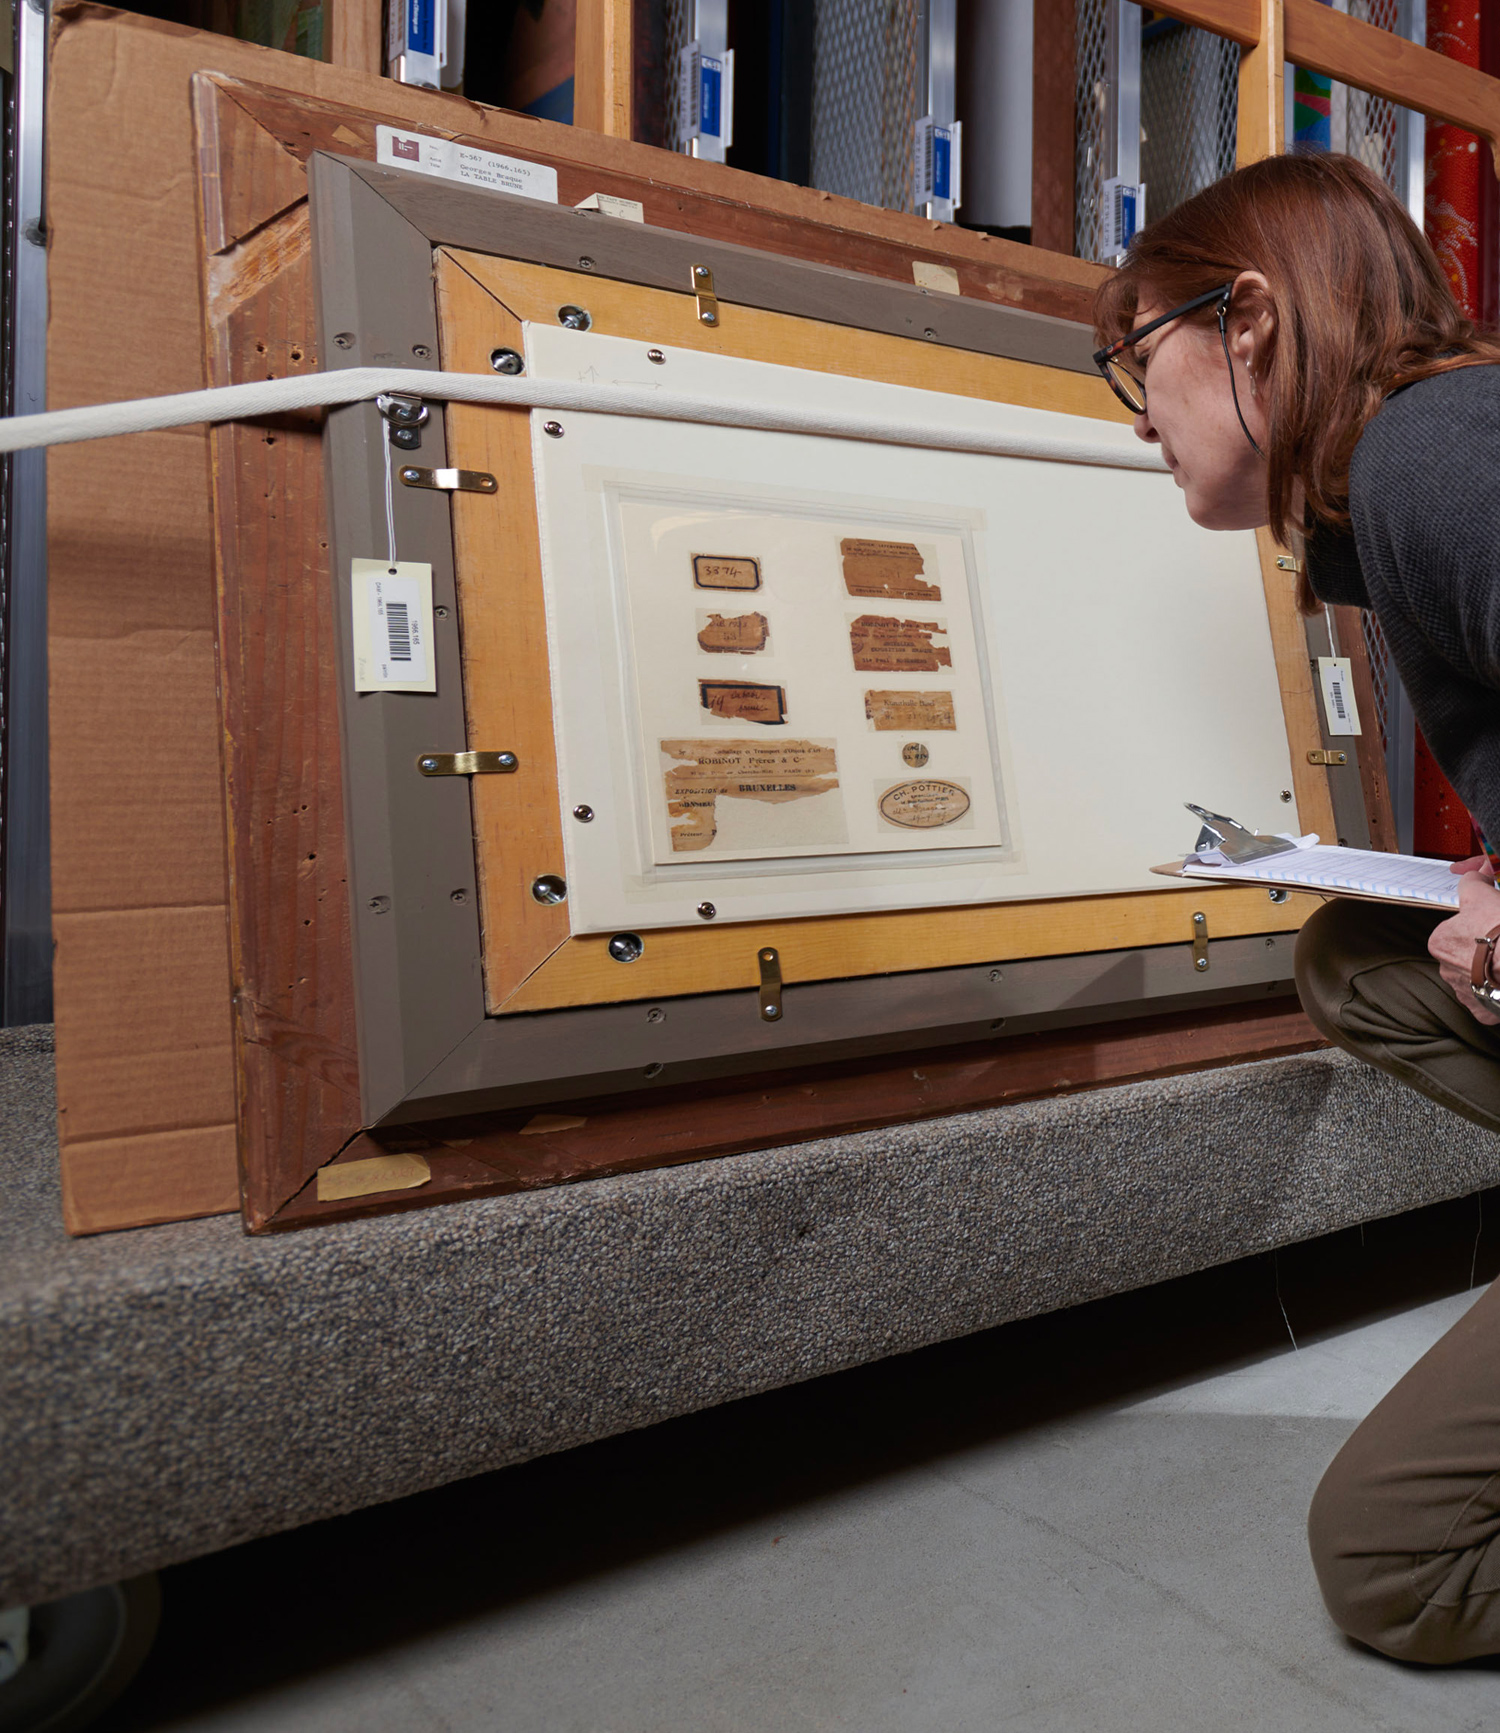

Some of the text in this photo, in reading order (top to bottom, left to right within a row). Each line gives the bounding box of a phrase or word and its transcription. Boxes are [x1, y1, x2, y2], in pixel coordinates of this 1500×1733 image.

[459, 152, 531, 177] E-567 (1966.165)
[460, 163, 523, 183] Georges Braque
[460, 170, 523, 191] LA TABLE BRUNE
[704, 565, 742, 578] 3374
[411, 620, 421, 645] 1966.165
[698, 757, 741, 765] ROBINOT
[739, 783, 797, 792] BRUXELLES
[911, 784, 955, 796] POTTIER
